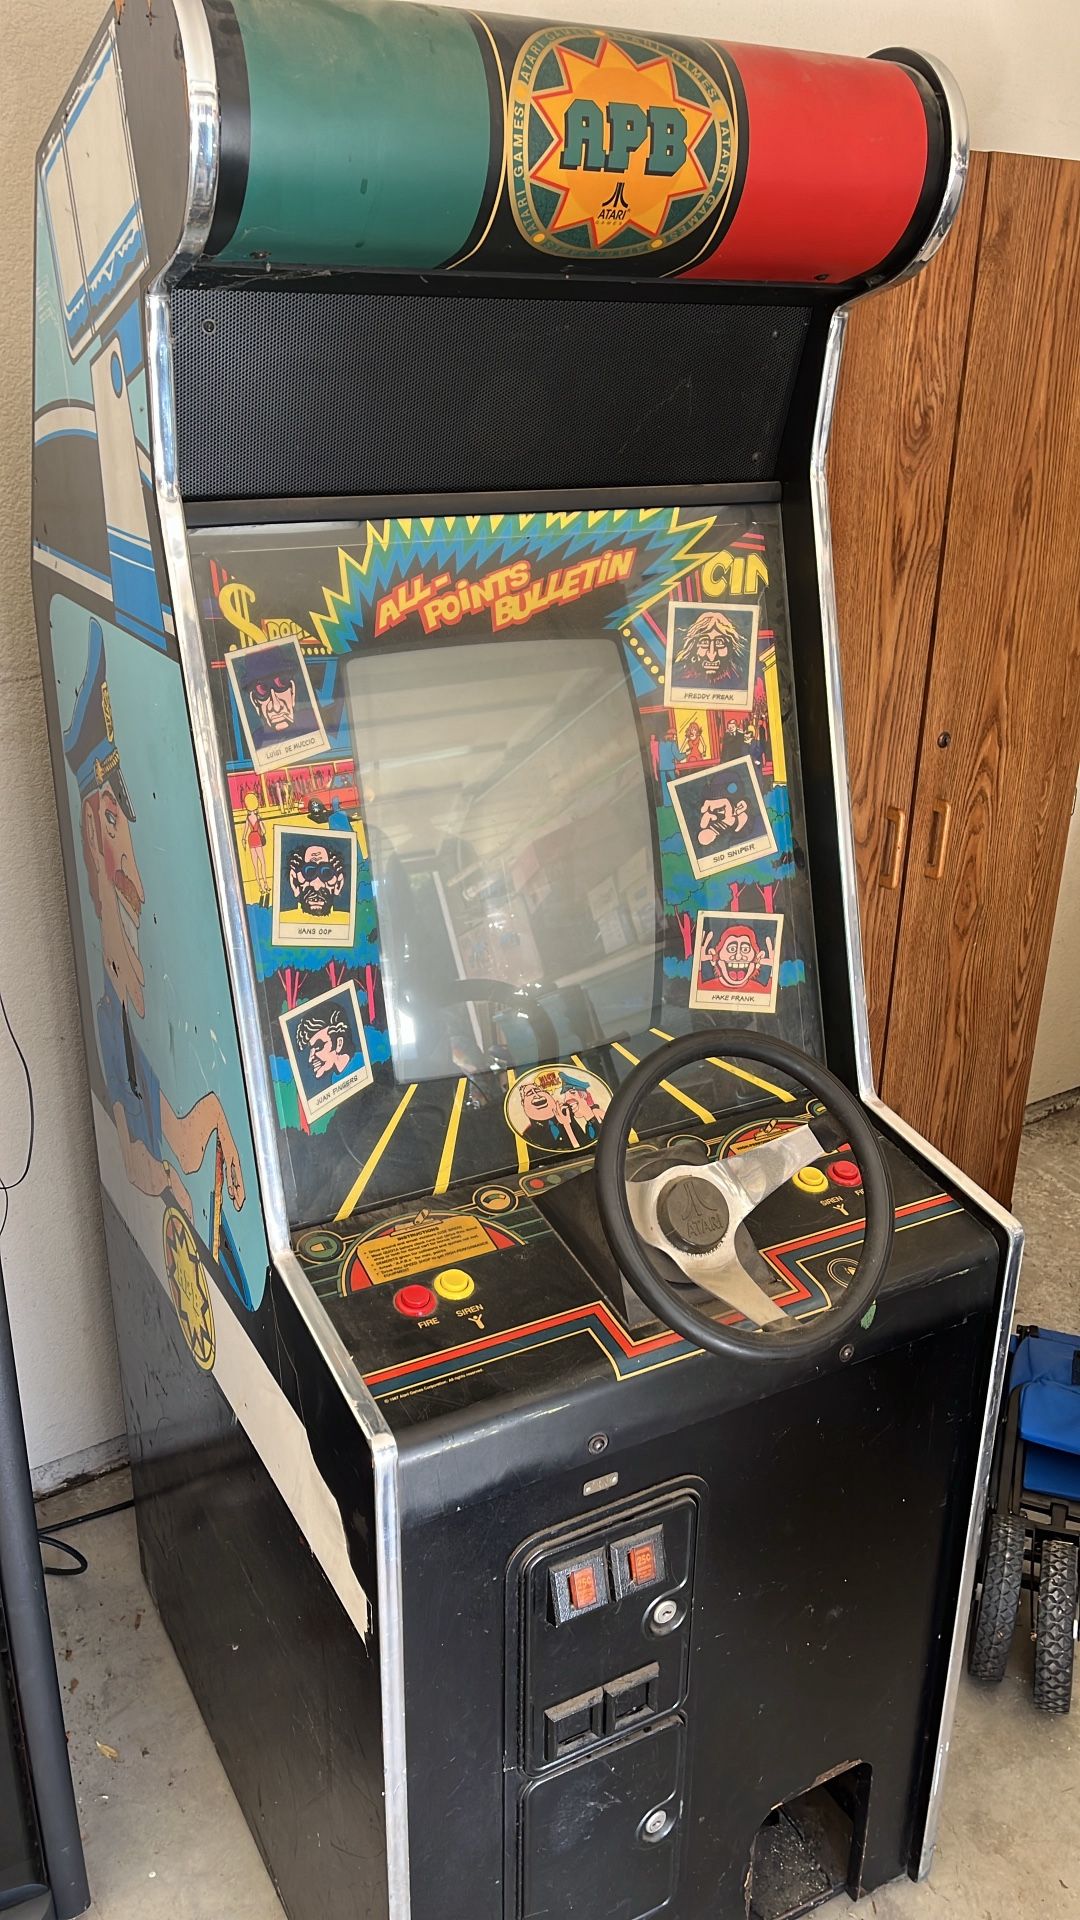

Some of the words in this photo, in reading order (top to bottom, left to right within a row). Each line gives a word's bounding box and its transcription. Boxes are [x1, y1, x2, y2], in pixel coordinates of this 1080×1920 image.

[520, 41, 545, 81] ATARI
[672, 51, 717, 98] GAMES
[513, 106, 524, 178] GAMES
[559, 98, 688, 177] APB
[717, 127, 731, 183] ATARI
[598, 209, 627, 220] ATARI
[421, 561, 530, 632] POINTS
[494, 549, 636, 630] BULLETIN
[684, 692, 710, 700] FREDDY
[711, 693, 734, 701] FREAK
[285, 745, 292, 753] DE
[713, 854, 725, 863] SID
[727, 843, 755, 858] SNIPER
[820, 1195, 843, 1206] SIREN
[686, 1213, 724, 1239] ATARI
[417, 1317, 440, 1329] FIRE
[456, 1303, 484, 1317] SIREN
